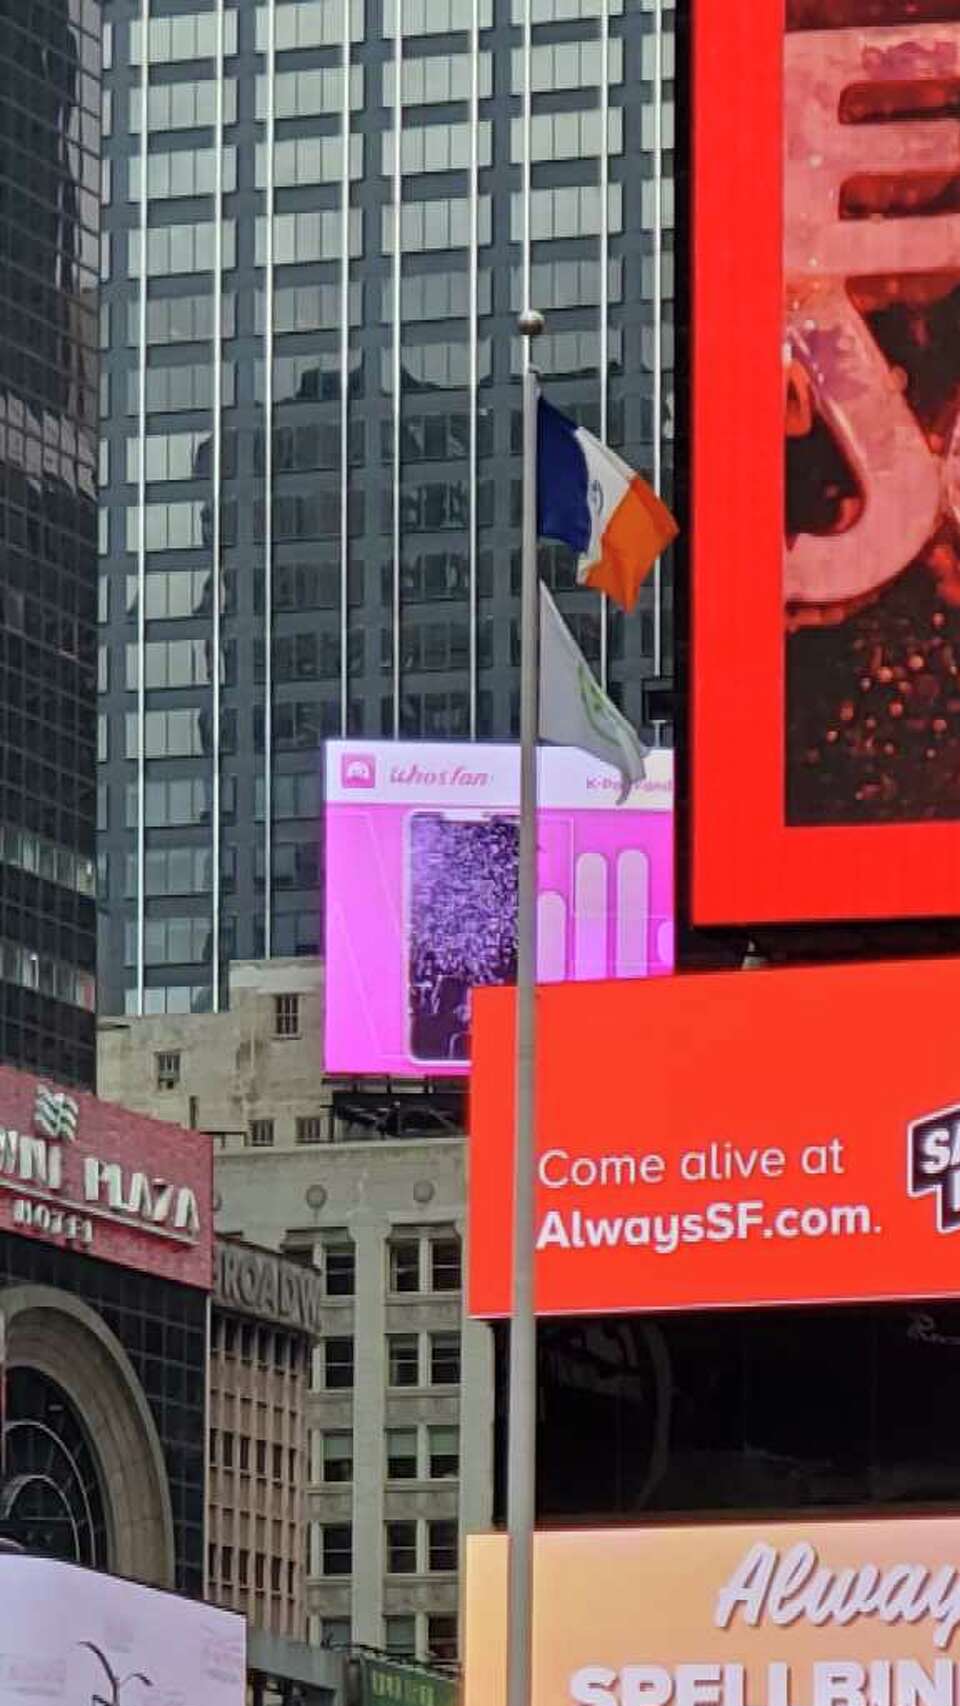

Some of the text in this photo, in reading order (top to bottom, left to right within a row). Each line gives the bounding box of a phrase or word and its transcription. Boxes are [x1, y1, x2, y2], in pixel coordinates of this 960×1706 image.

[537, 1137, 845, 1189] Come alive at
[83, 1157, 200, 1232] PLAZA
[535, 1200, 882, 1255] AlwaysSF.com.
